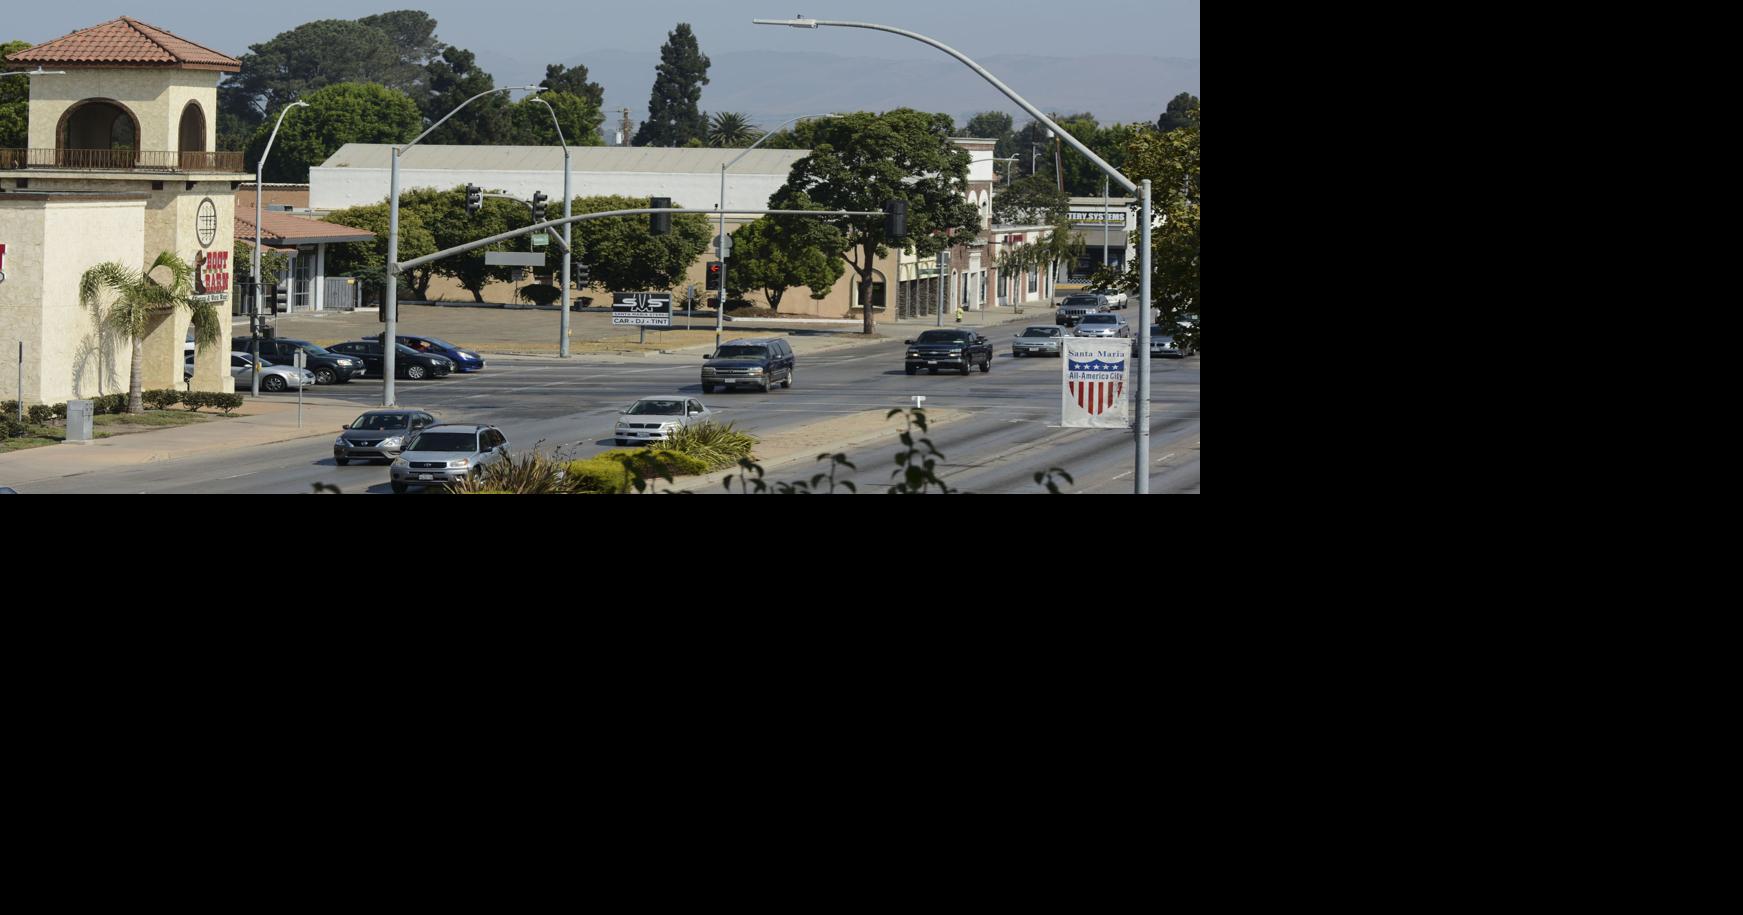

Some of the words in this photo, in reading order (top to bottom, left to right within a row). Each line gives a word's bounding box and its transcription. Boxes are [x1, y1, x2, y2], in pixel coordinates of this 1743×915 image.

[207, 251, 228, 269] BOOT
[205, 272, 229, 292] BARN
[1069, 372, 1109, 380] All-America
[1110, 372, 1123, 380] City
